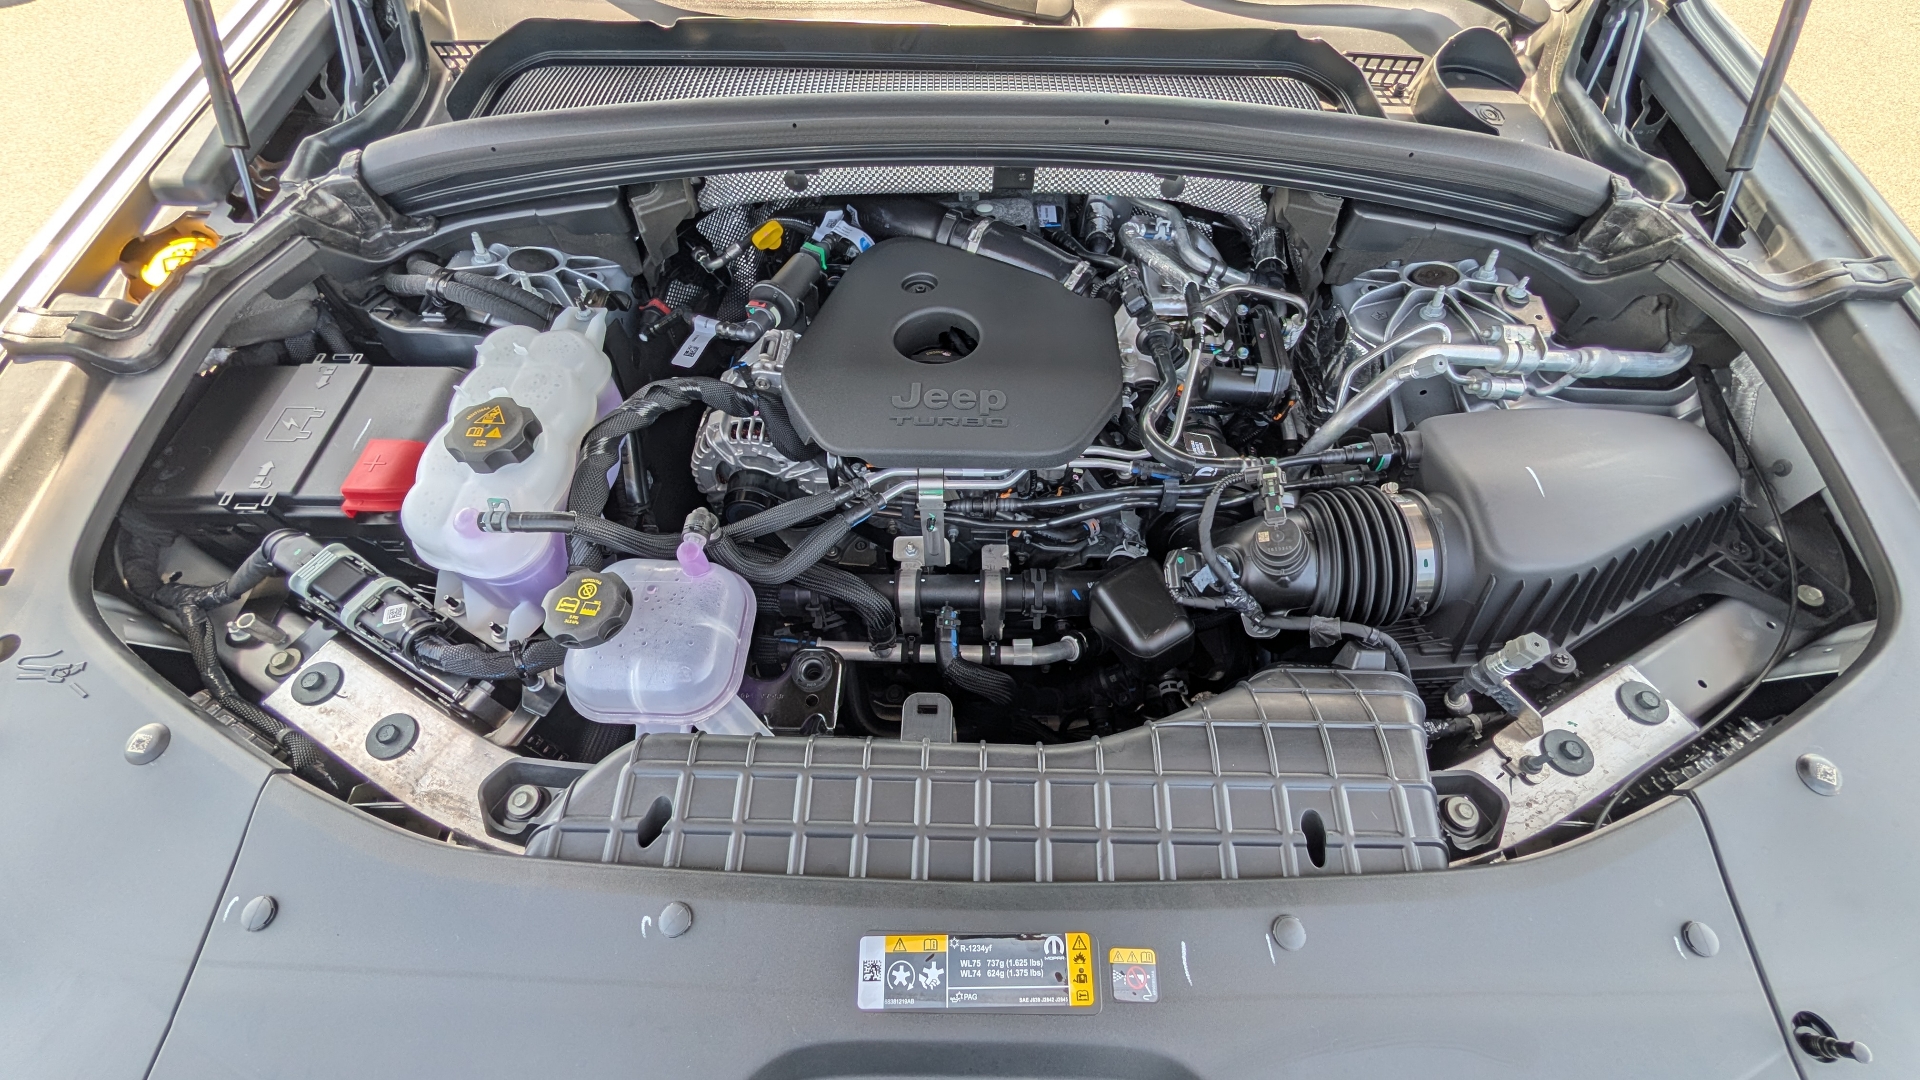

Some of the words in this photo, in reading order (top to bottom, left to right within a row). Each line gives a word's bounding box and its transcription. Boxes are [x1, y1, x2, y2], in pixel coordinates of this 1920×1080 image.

[891, 382, 1007, 416] Jeep
[889, 416, 1009, 428] TURBO
[960, 944, 993, 954] R-1234yf
[960, 960, 981, 968] WL75
[987, 959, 1004, 969] 737g
[1006, 959, 1028, 968] (1.625
[1030, 959, 1044, 968] lbs)
[960, 969, 981, 978] WL74
[987, 969, 1004, 979] 624g
[1006, 969, 1028, 978] (1.375
[1030, 968, 1044, 978] lbs)
